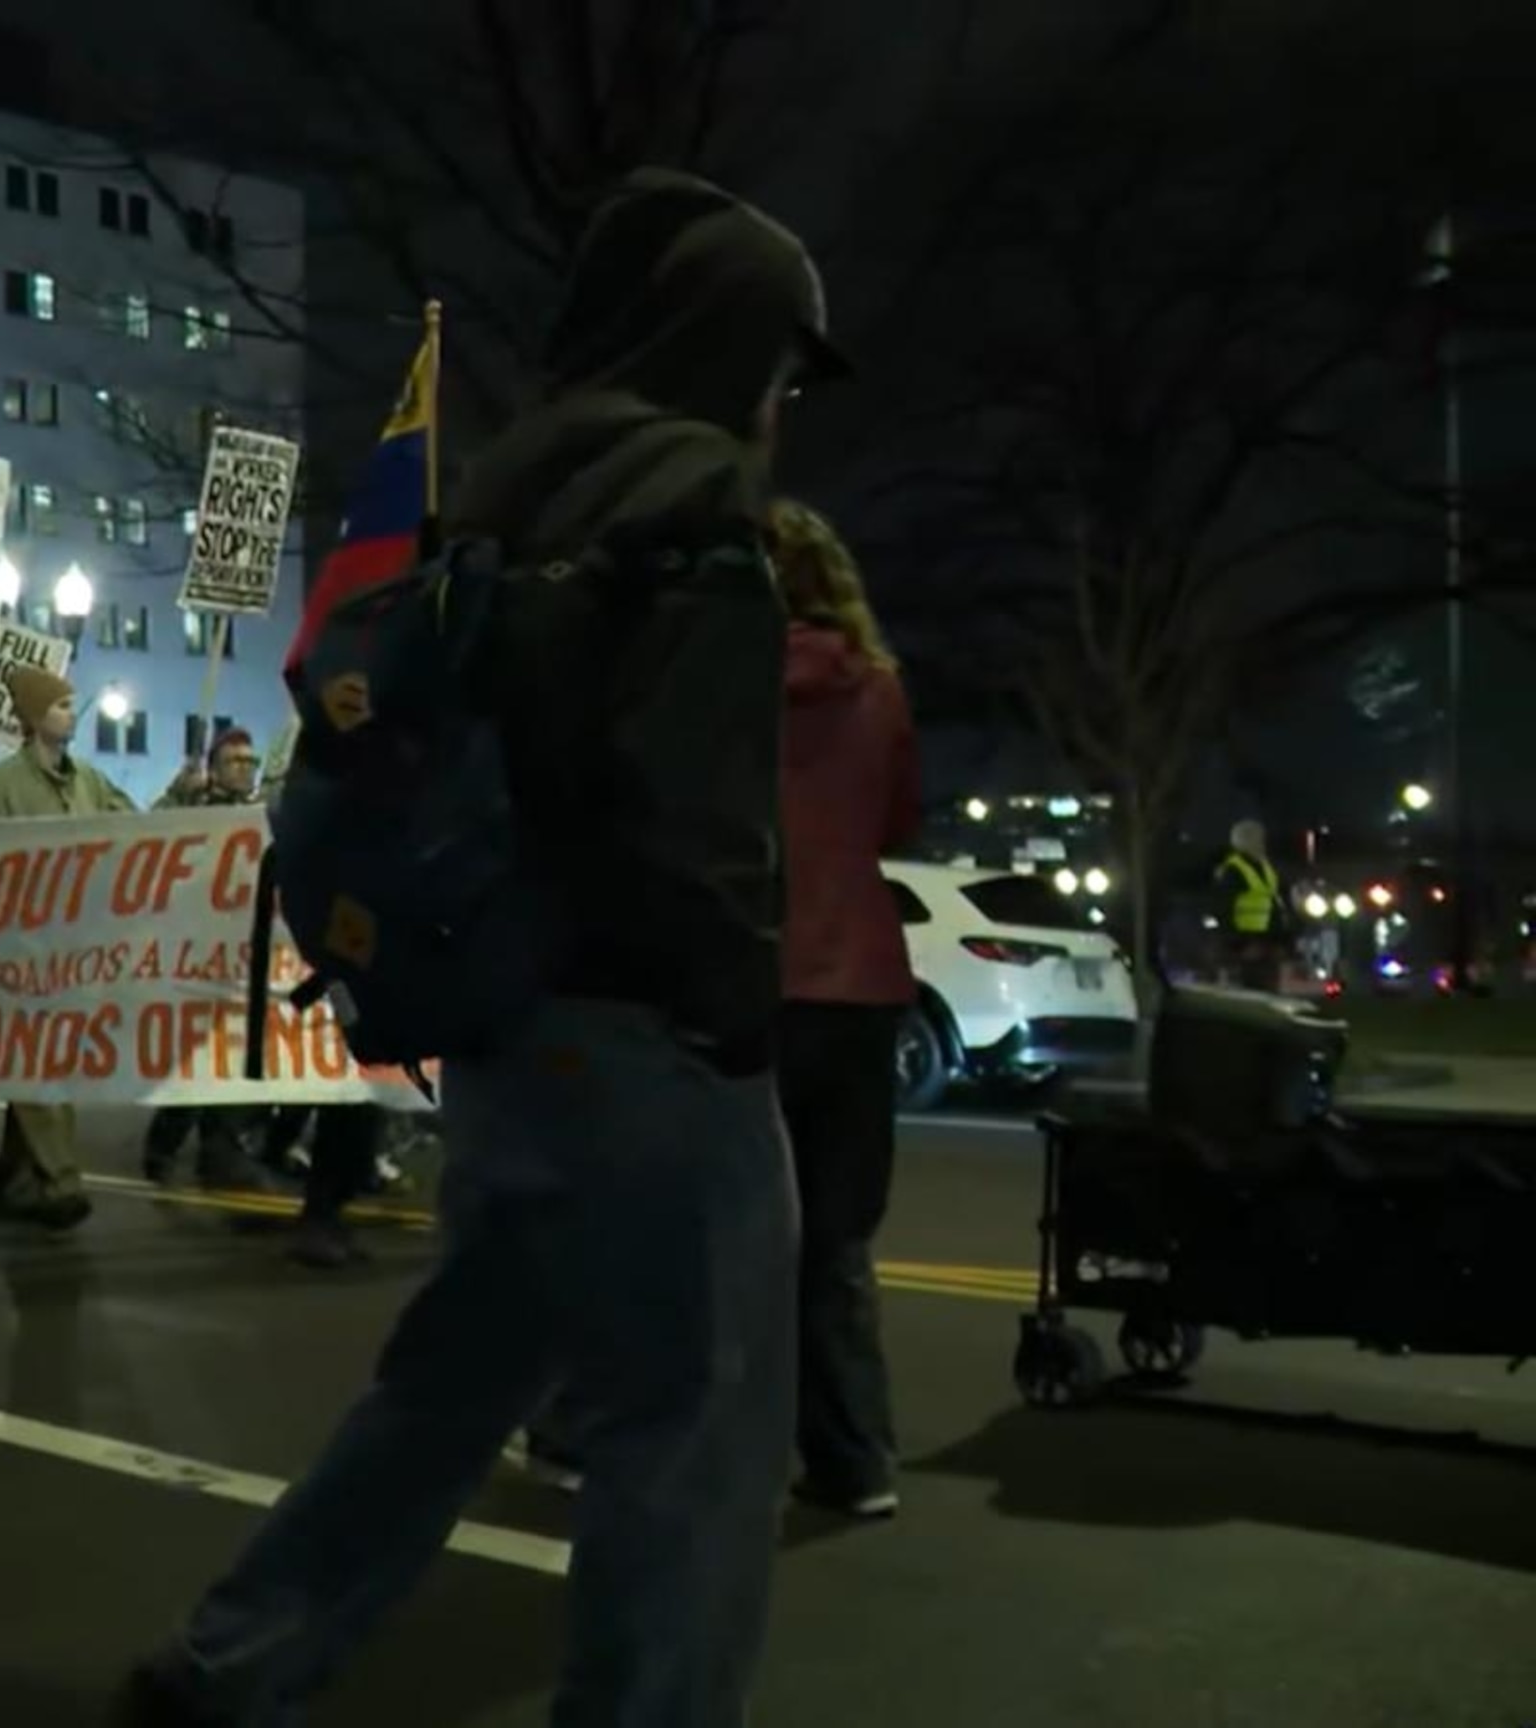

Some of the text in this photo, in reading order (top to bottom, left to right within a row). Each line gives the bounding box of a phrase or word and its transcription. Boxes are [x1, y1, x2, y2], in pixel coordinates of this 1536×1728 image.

[204, 475, 284, 524] RIGHTS
[196, 521, 247, 560] STOP
[0, 628, 50, 669] FULL
[110, 834, 208, 917] OF
[133, 937, 162, 980] A
[136, 1001, 246, 1081] OFF
